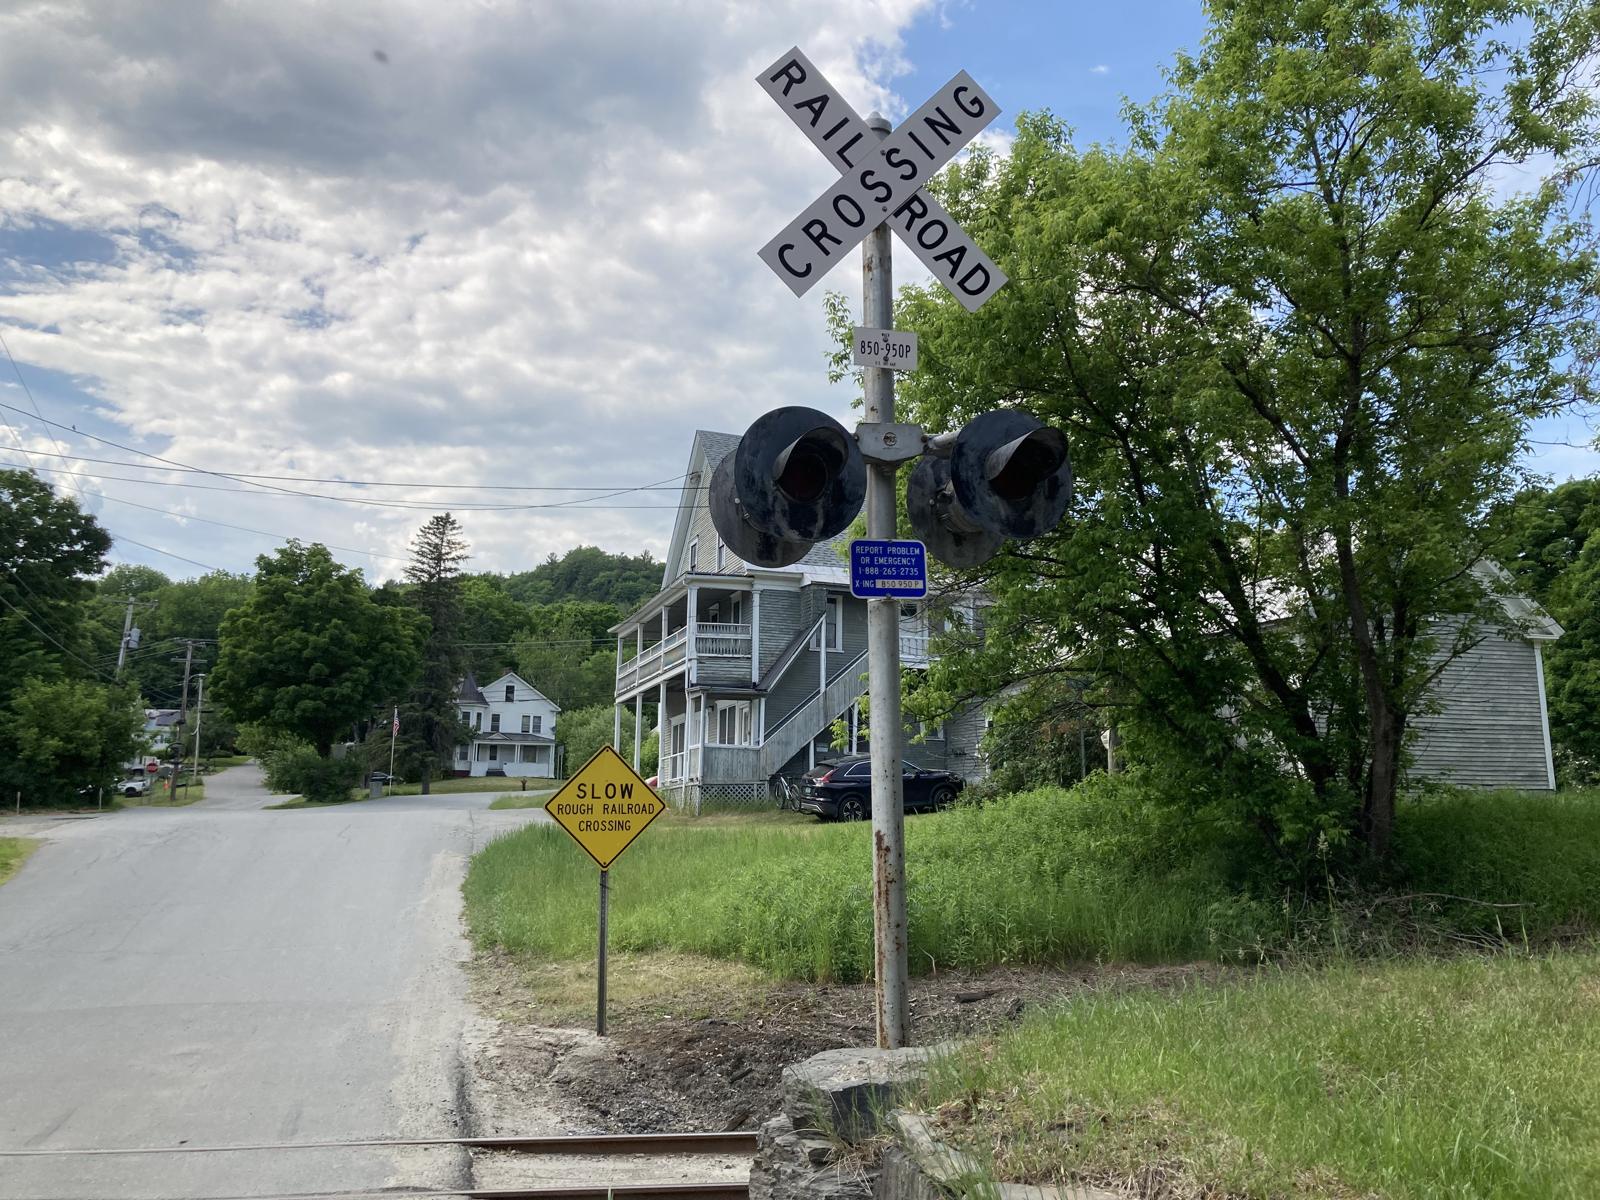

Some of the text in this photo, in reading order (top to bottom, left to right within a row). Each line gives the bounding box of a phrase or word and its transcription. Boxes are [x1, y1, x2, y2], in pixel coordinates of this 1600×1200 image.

[770, 58, 991, 297] RAIL ROAD
[777, 85, 985, 278] CROSSING
[860, 340, 911, 358] 850-950P
[855, 546, 920, 555] REPORT PROBLEM
[860, 556, 916, 565] OR EMERGENCY
[576, 783, 634, 799] SLOW
[557, 803, 655, 815] ROUGH RAILROAD
[578, 820, 631, 831] CROSSING
